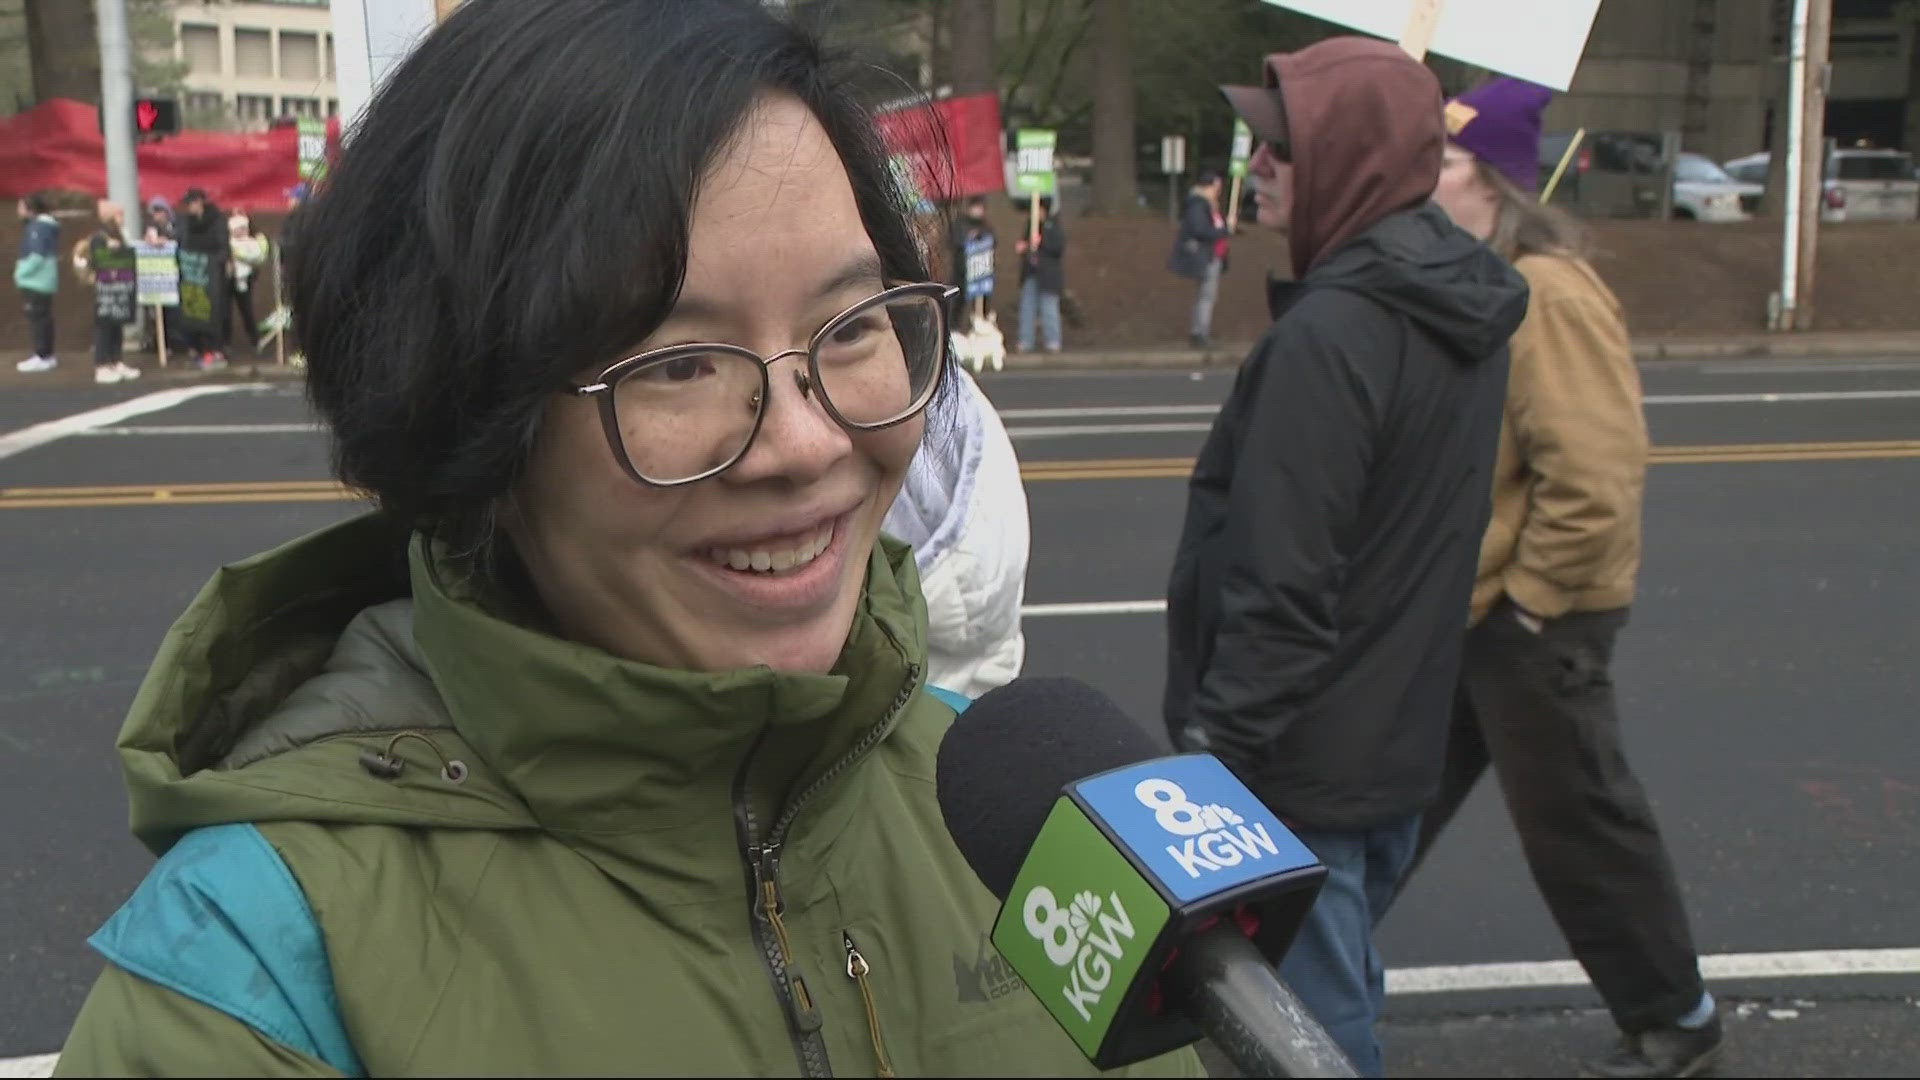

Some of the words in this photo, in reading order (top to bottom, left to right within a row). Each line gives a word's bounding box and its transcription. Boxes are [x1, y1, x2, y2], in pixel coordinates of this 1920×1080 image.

[1134, 778, 1207, 836] 8
[1165, 822, 1280, 879] KGW
[1023, 885, 1080, 967] 8
[1062, 890, 1136, 1022] KGW
